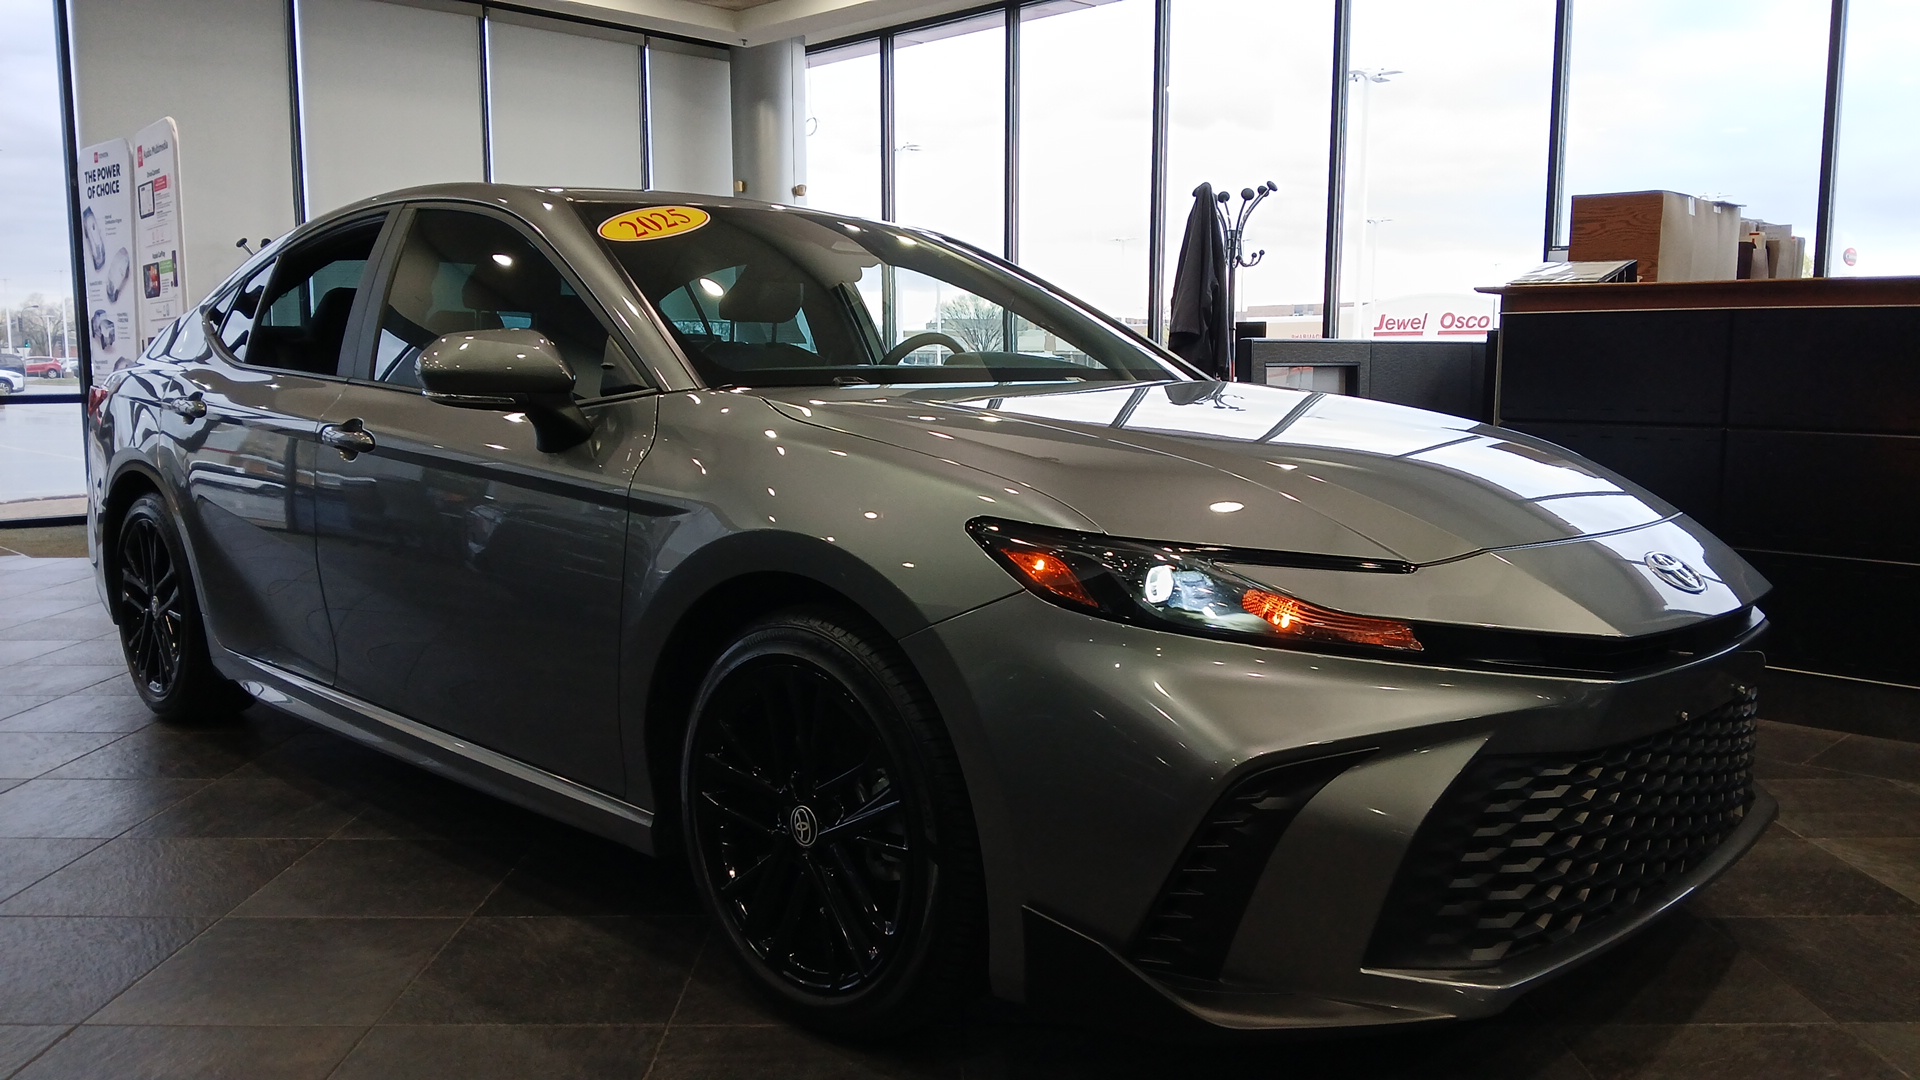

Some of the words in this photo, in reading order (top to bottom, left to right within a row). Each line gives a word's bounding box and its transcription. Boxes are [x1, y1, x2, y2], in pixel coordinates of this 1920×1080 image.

[84, 169, 97, 184] THE
[97, 163, 121, 181] POWER
[87, 184, 96, 199] OF
[96, 180, 120, 197] CHOICE
[619, 208, 691, 238] 2025
[1373, 313, 1428, 331] Jewel
[1439, 312, 1490, 329] Osco
